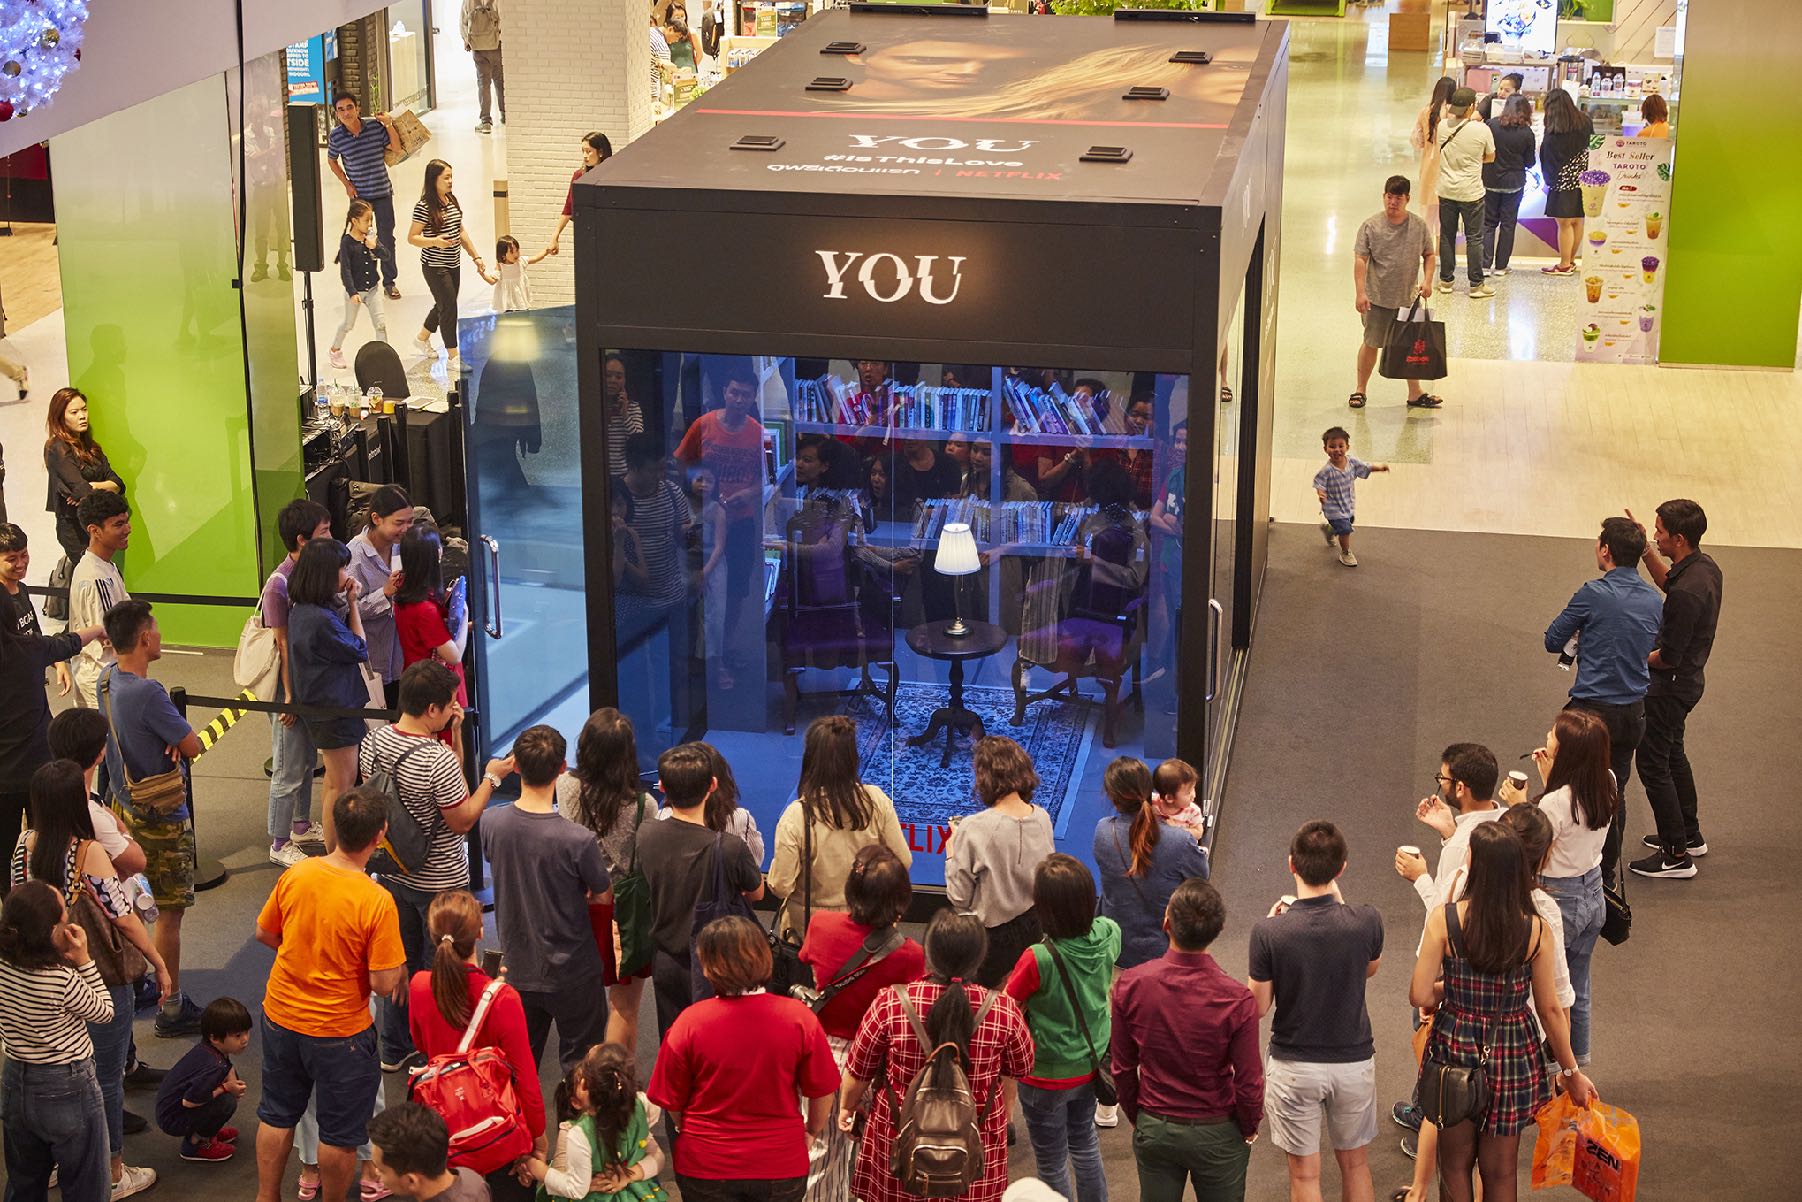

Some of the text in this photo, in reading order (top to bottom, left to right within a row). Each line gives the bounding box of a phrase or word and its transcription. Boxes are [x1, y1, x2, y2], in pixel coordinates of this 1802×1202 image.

[849, 134, 1040, 151] YOU
[823, 154, 1024, 168] #IsThisLove
[1606, 150, 1656, 161] Best Seller
[1613, 163, 1647, 171] TAROTO
[956, 171, 1062, 182] NETFLIX
[815, 250, 967, 304] YOU
[901, 823, 953, 855] LIX
